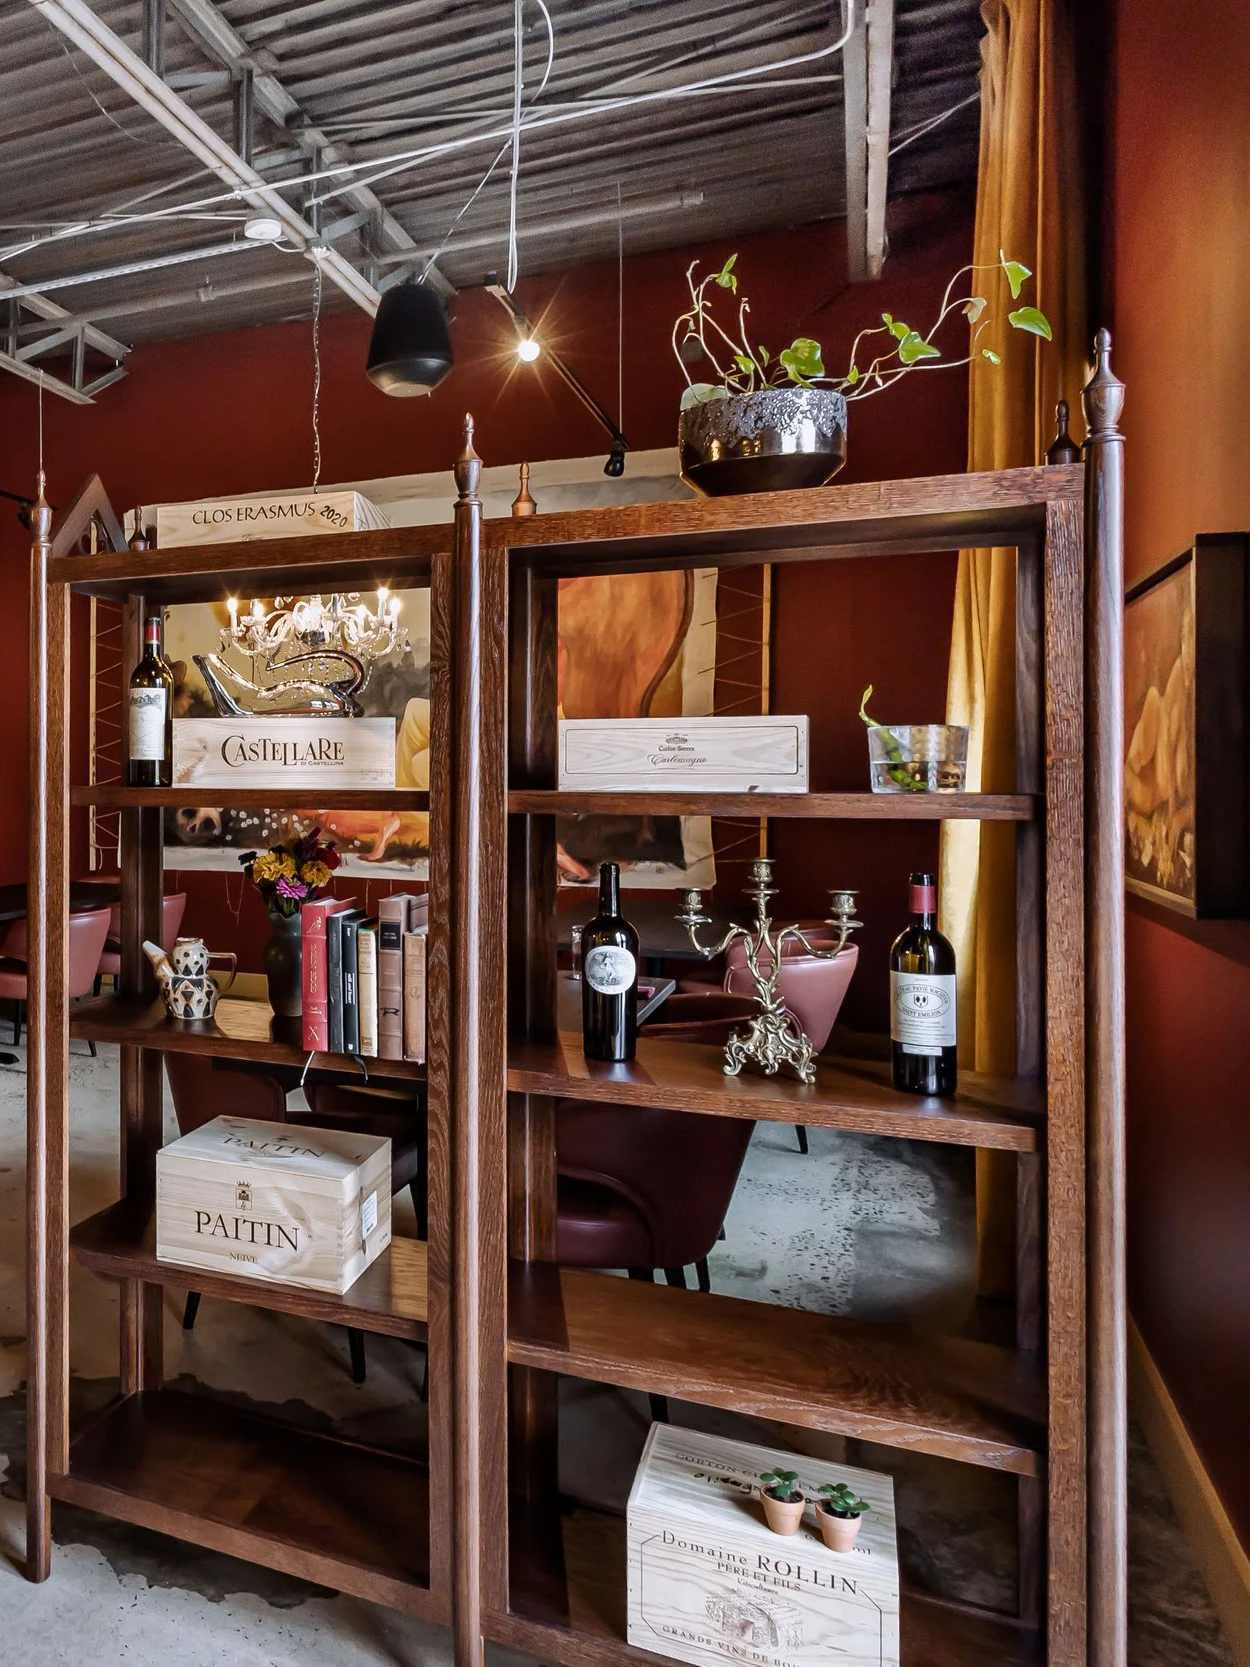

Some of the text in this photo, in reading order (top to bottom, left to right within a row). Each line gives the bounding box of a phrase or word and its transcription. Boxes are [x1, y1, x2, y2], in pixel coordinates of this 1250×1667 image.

[192, 502, 348, 528] CLOS ERASMUS 2020
[221, 733, 345, 767] CASTELLARE
[224, 1137, 324, 1158] PAITIN
[194, 1210, 299, 1251] PAITIN
[229, 1252, 258, 1264] NEIVE
[675, 1454, 736, 1473] CORTON
[662, 1530, 859, 1595] Domaine ROLLIN
[753, 1572, 769, 1584] ET
[773, 1577, 802, 1592] FILS
[662, 1625, 712, 1646] GRANDS
[717, 1641, 747, 1657] VINS
[752, 1652, 769, 1663] DE
